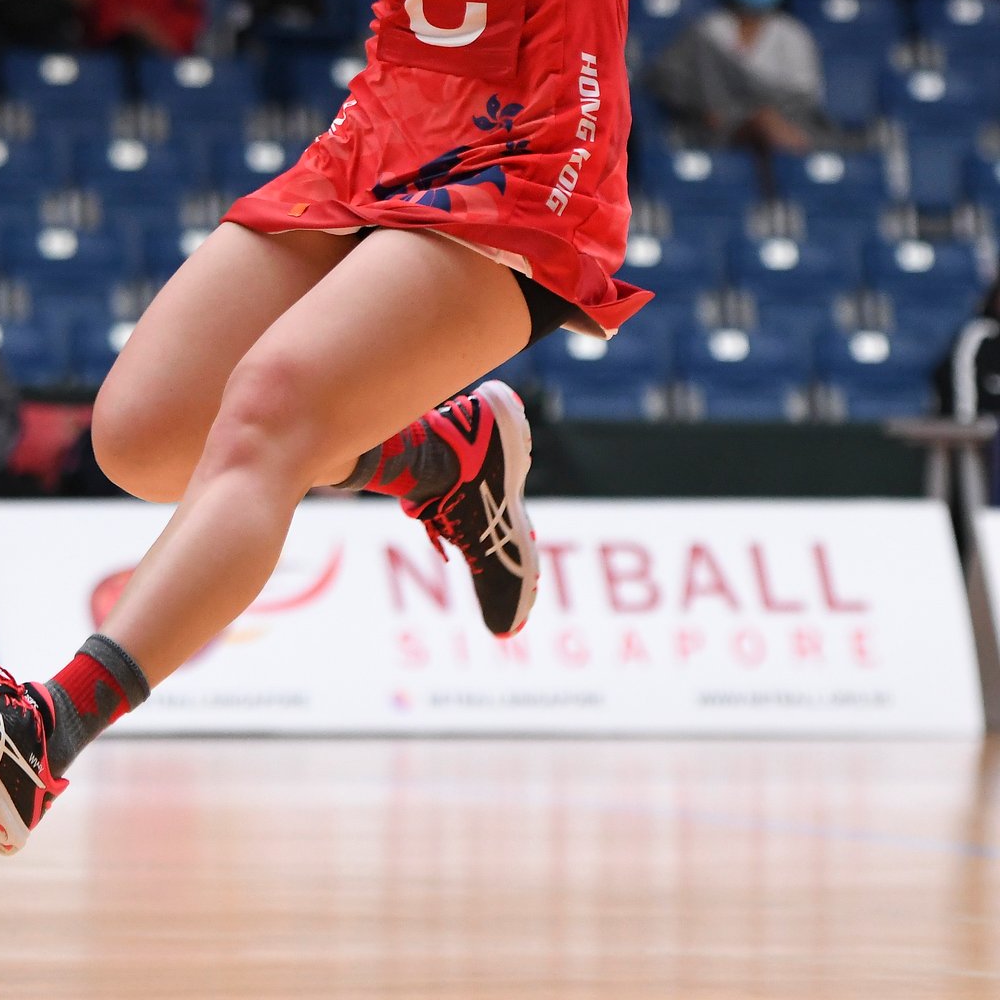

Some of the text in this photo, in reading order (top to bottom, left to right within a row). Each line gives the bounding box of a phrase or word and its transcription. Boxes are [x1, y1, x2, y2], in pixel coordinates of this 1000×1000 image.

[576, 52, 601, 143] HONG
[384, 543, 870, 613] NTBALL
[398, 625, 880, 670] SINGAPORE
